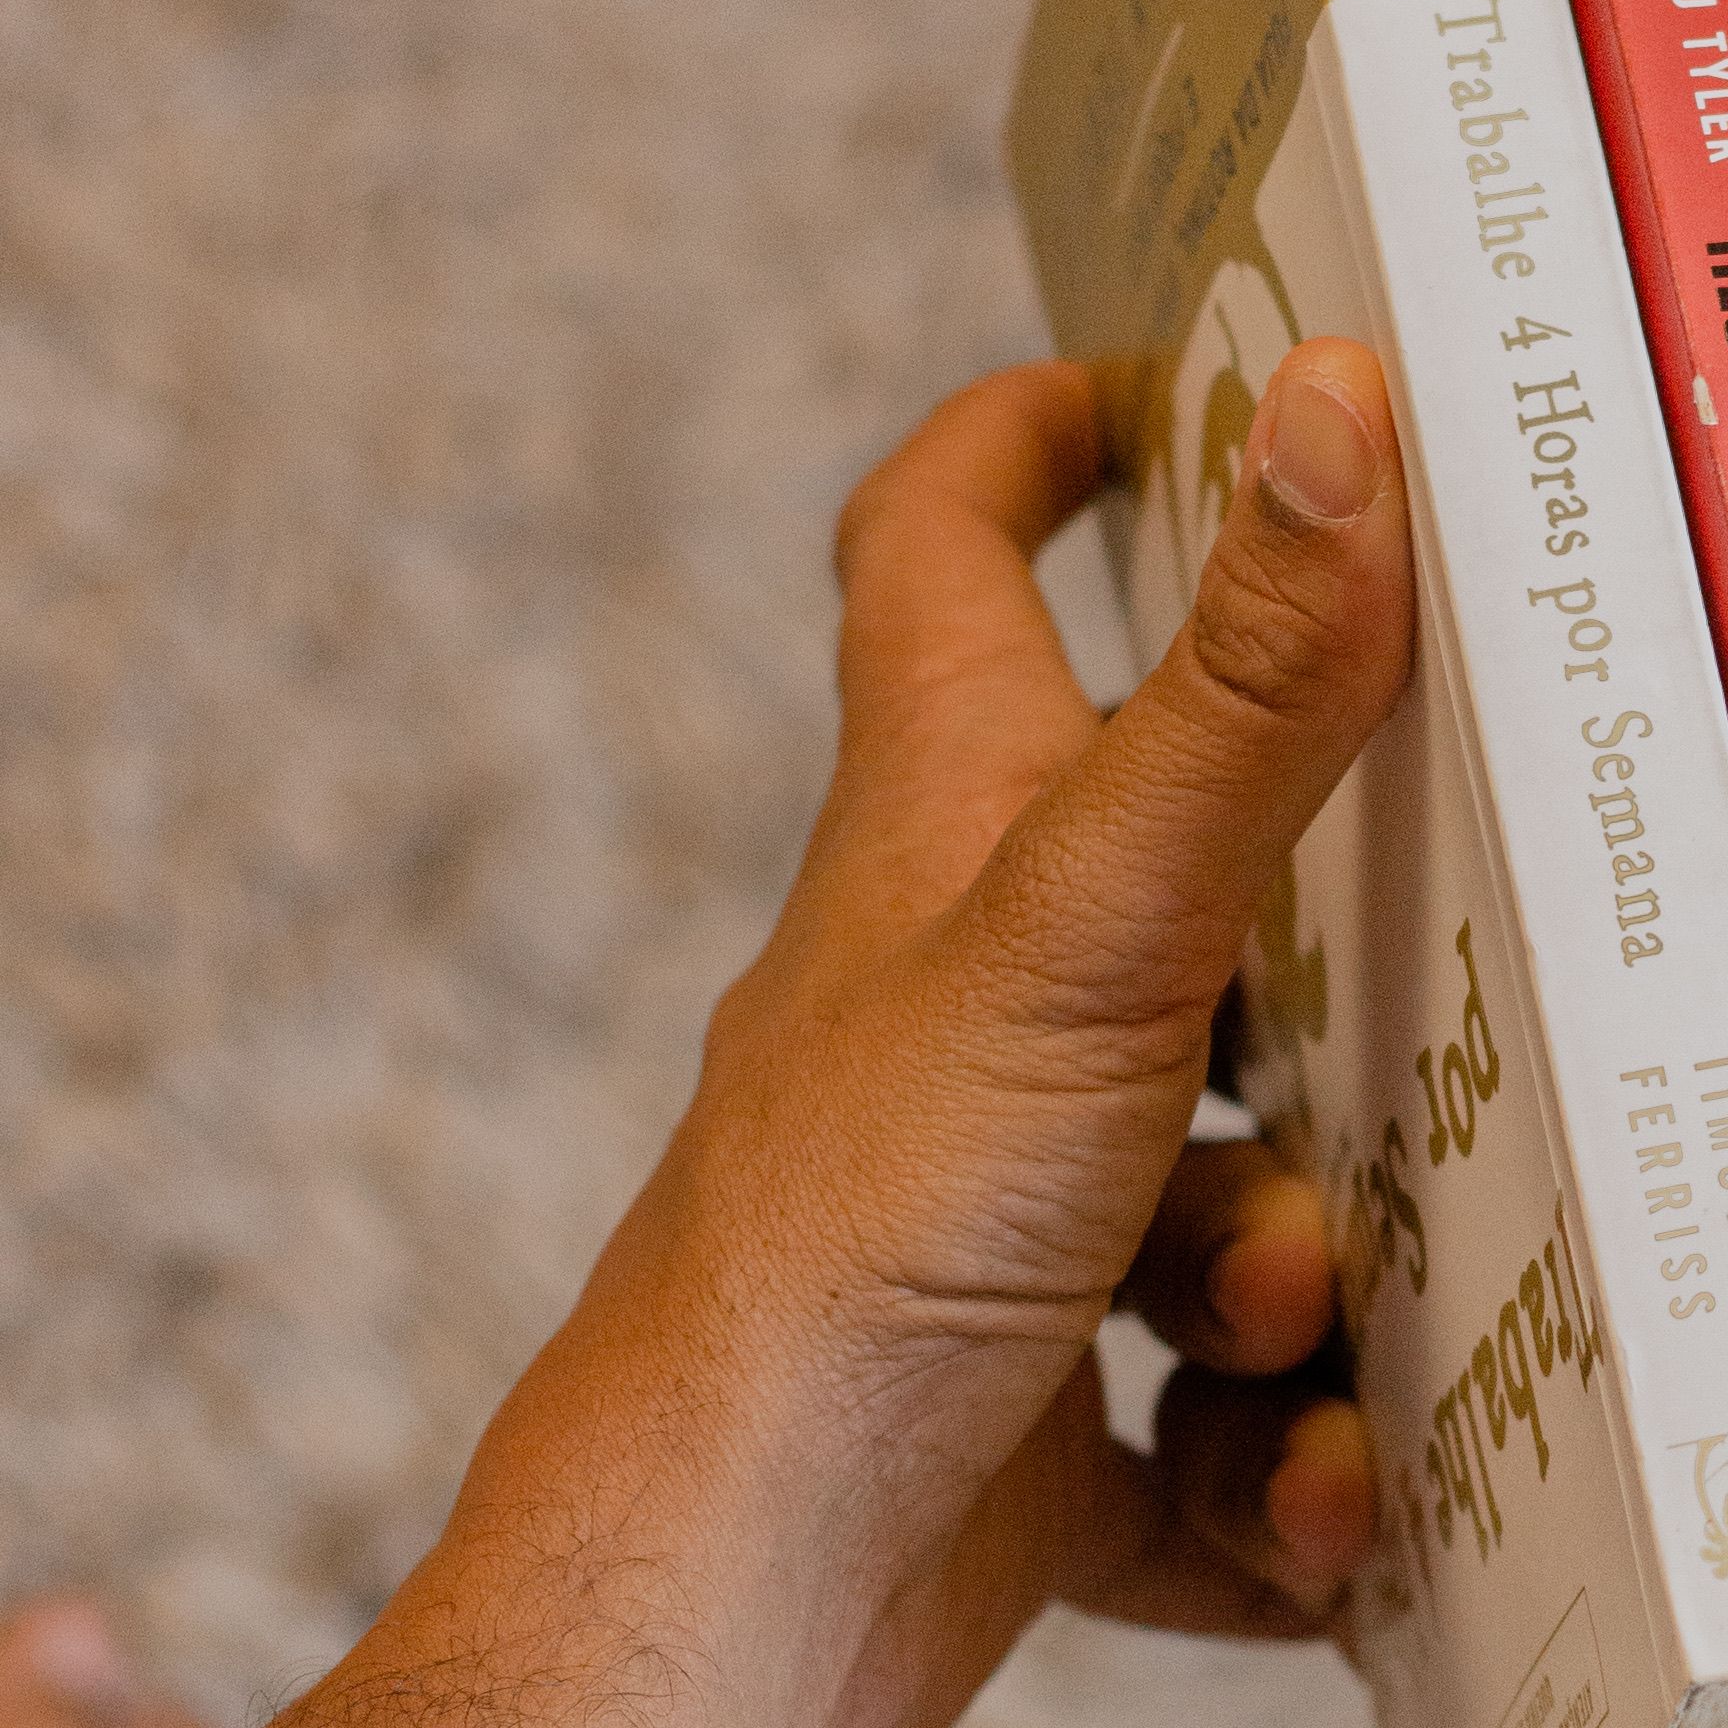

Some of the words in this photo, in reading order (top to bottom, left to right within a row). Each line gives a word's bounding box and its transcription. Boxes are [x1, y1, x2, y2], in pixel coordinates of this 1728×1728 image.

[1500, 315, 1572, 352] 4
[1512, 369, 1594, 556] Horas
[1527, 577, 1613, 682] por
[1581, 710, 1664, 967] Semana
[1619, 1065, 1716, 1319] FERRISS
